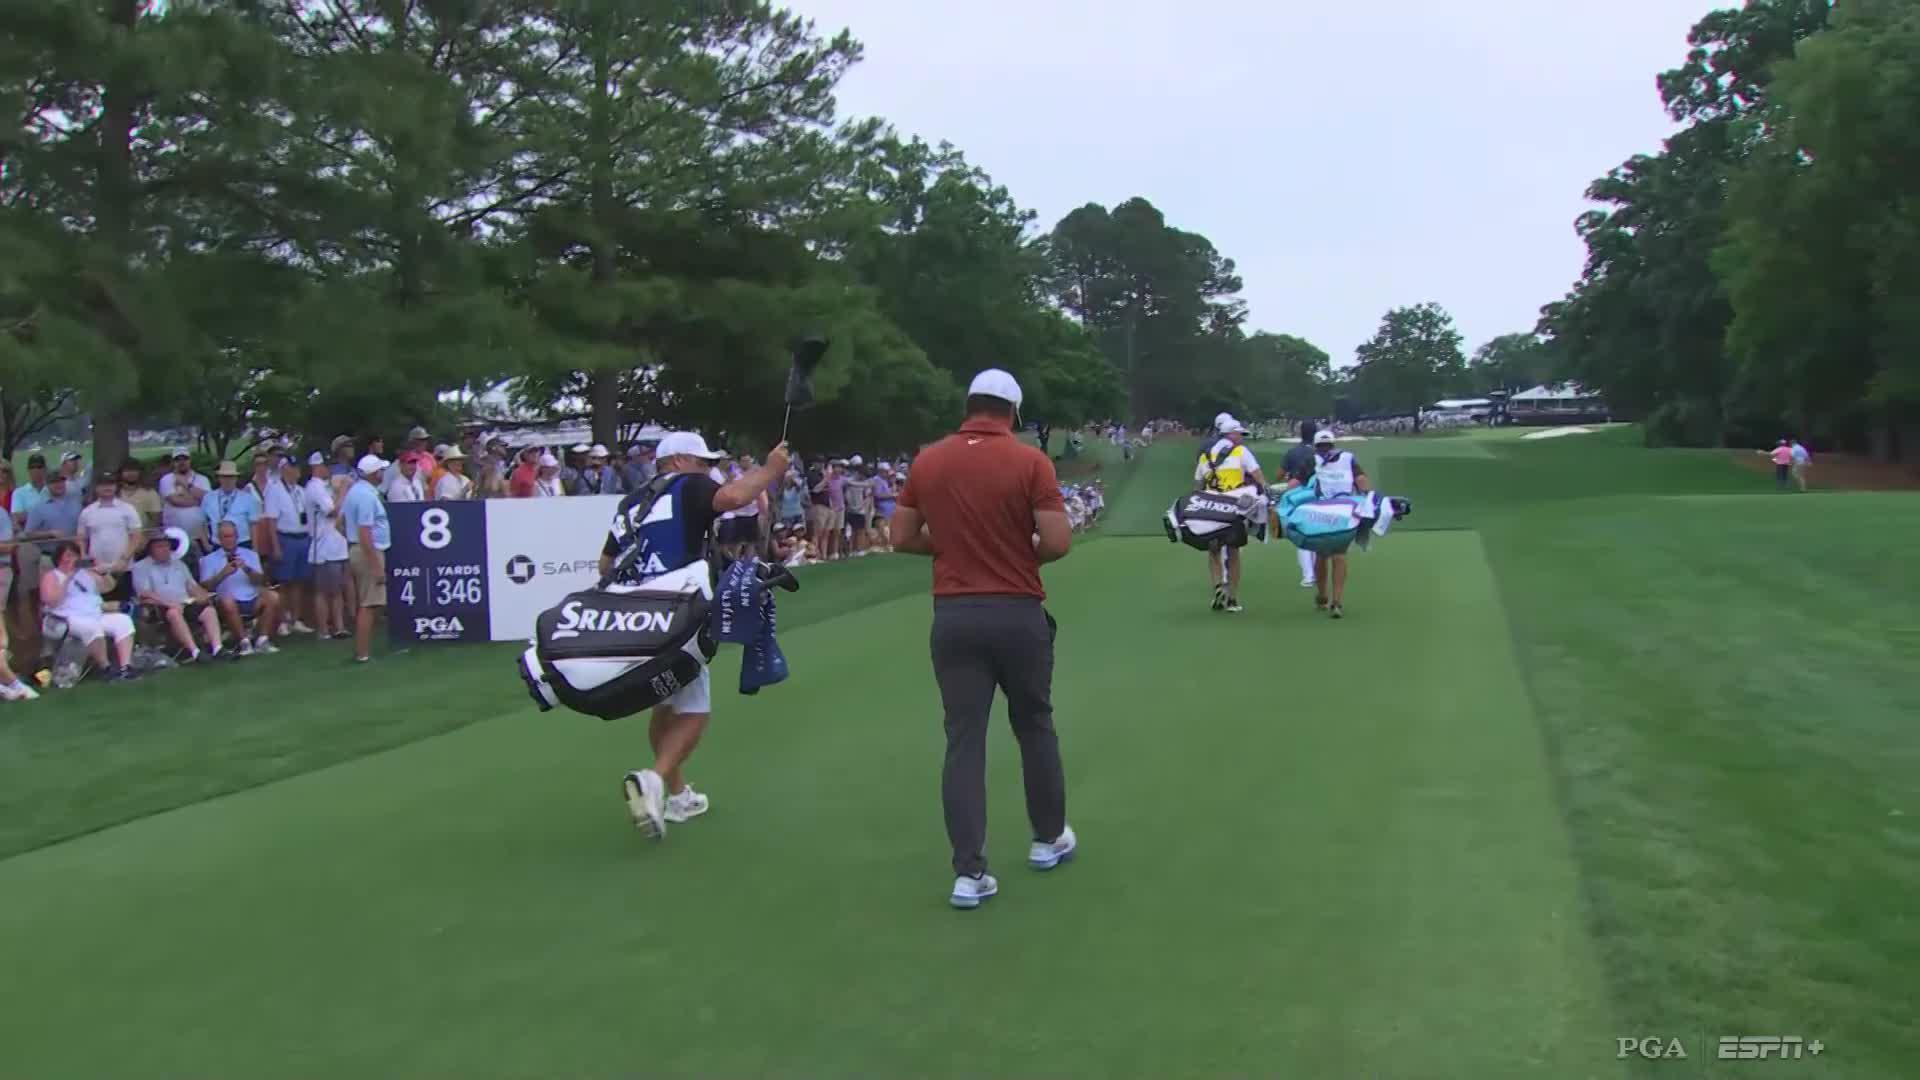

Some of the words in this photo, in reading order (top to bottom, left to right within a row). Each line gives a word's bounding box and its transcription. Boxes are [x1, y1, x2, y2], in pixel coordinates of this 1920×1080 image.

[420, 508, 452, 549] 8
[393, 567, 420, 577] PAR
[437, 565, 481, 576] YARDS
[400, 580, 416, 605] 4
[436, 578, 482, 605] 346
[414, 616, 465, 632] PGA
[552, 600, 675, 639] SRIXON
